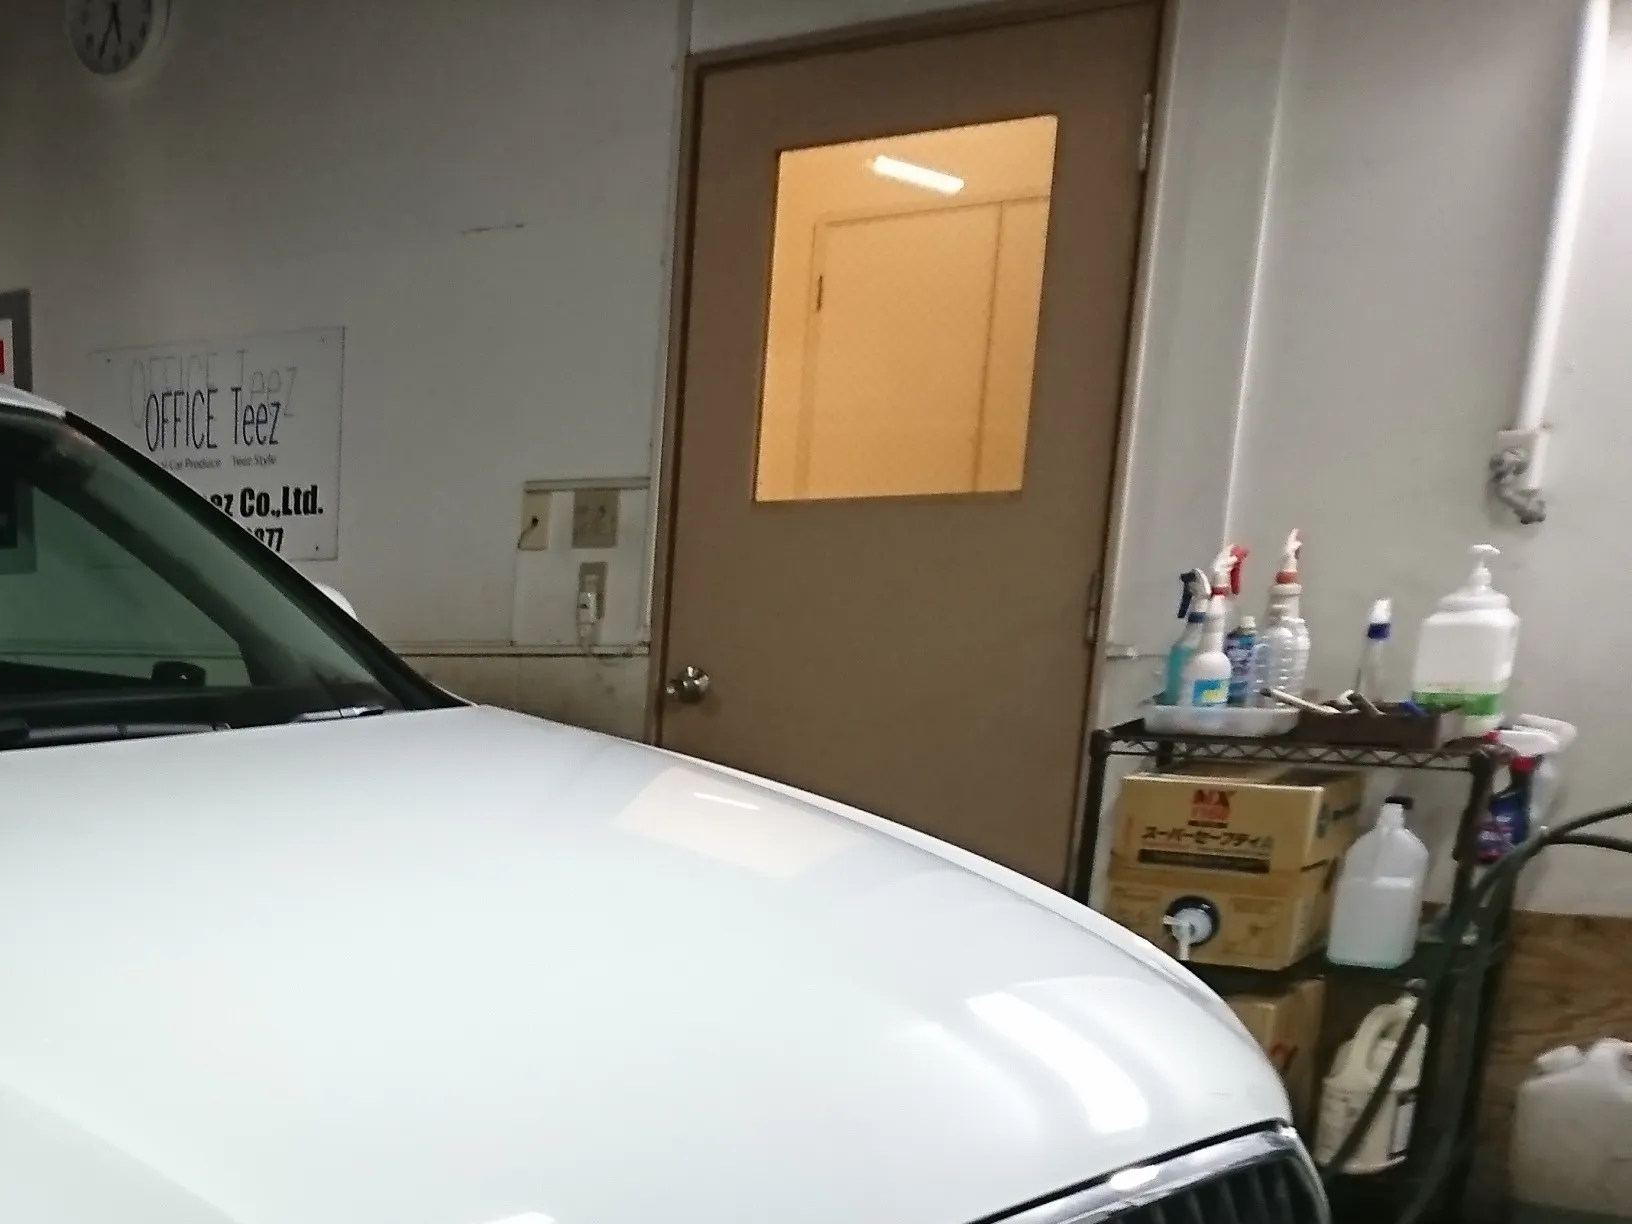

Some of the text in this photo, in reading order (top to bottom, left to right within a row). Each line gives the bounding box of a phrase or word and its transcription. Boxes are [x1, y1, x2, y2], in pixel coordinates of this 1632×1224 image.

[145, 386, 281, 452] OFFICE Teez
[239, 484, 324, 518] Co.,Ltd.
